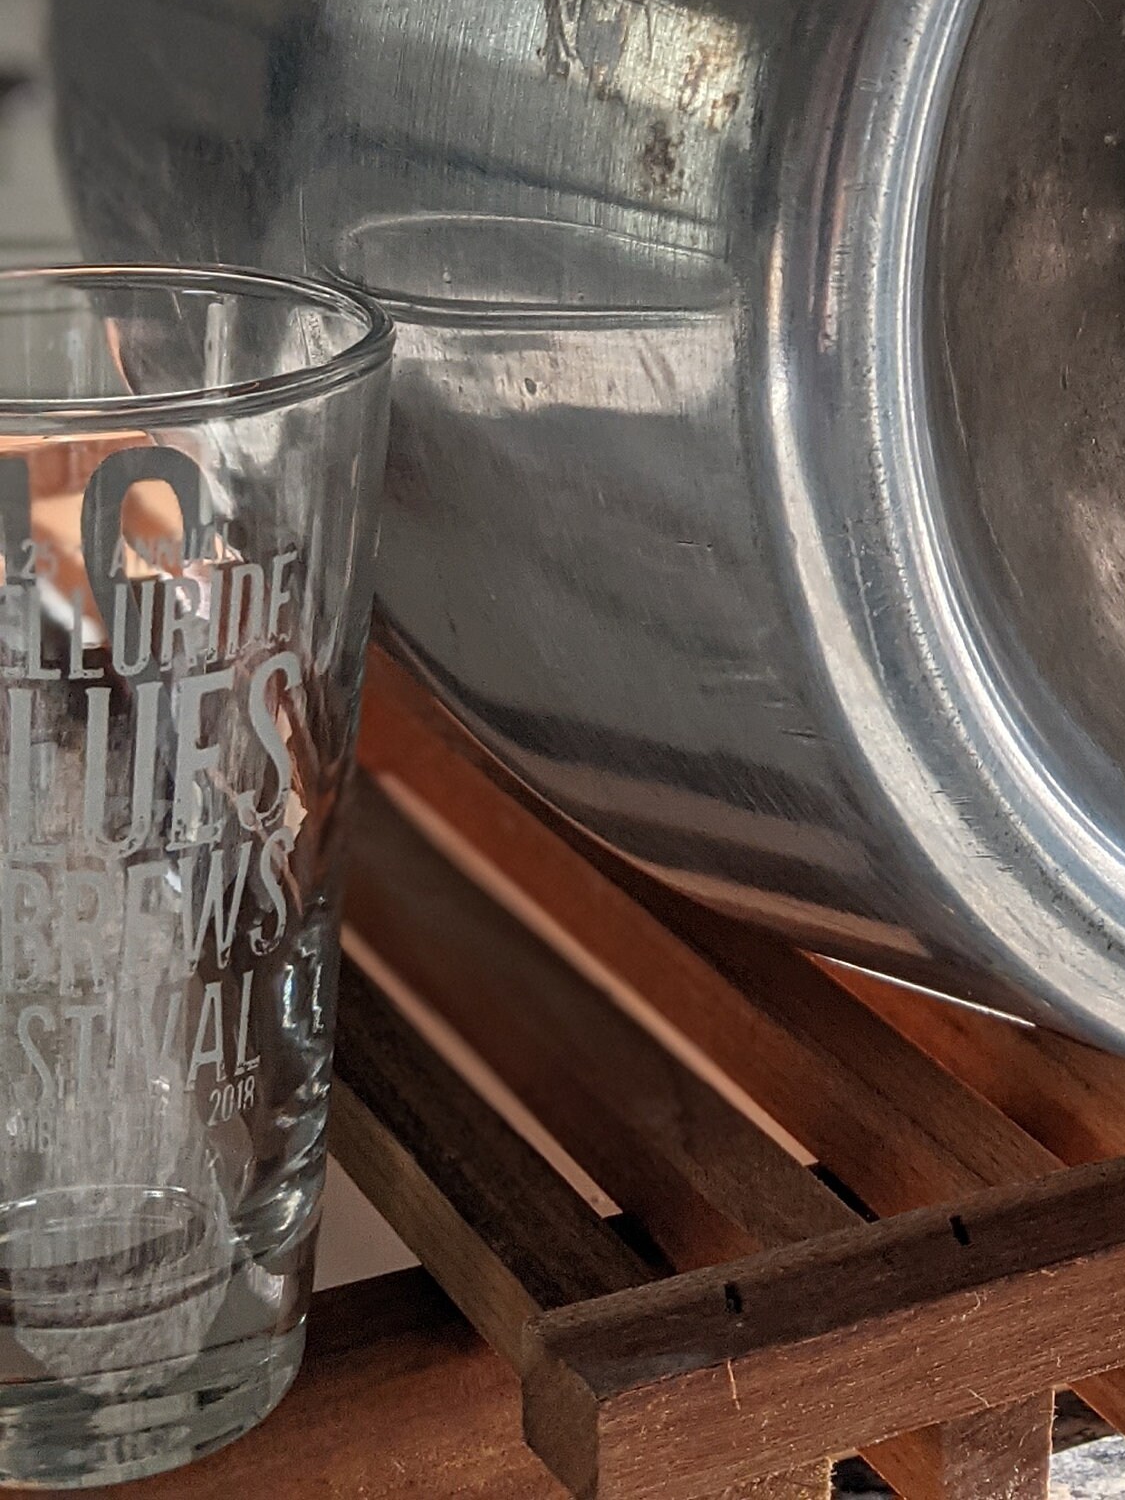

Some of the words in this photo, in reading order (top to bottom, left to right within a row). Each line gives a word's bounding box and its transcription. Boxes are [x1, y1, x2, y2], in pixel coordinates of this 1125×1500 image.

[8, 651, 302, 859] LUES
[0, 828, 295, 996] BREWS
[207, 1075, 256, 1127] 2018
